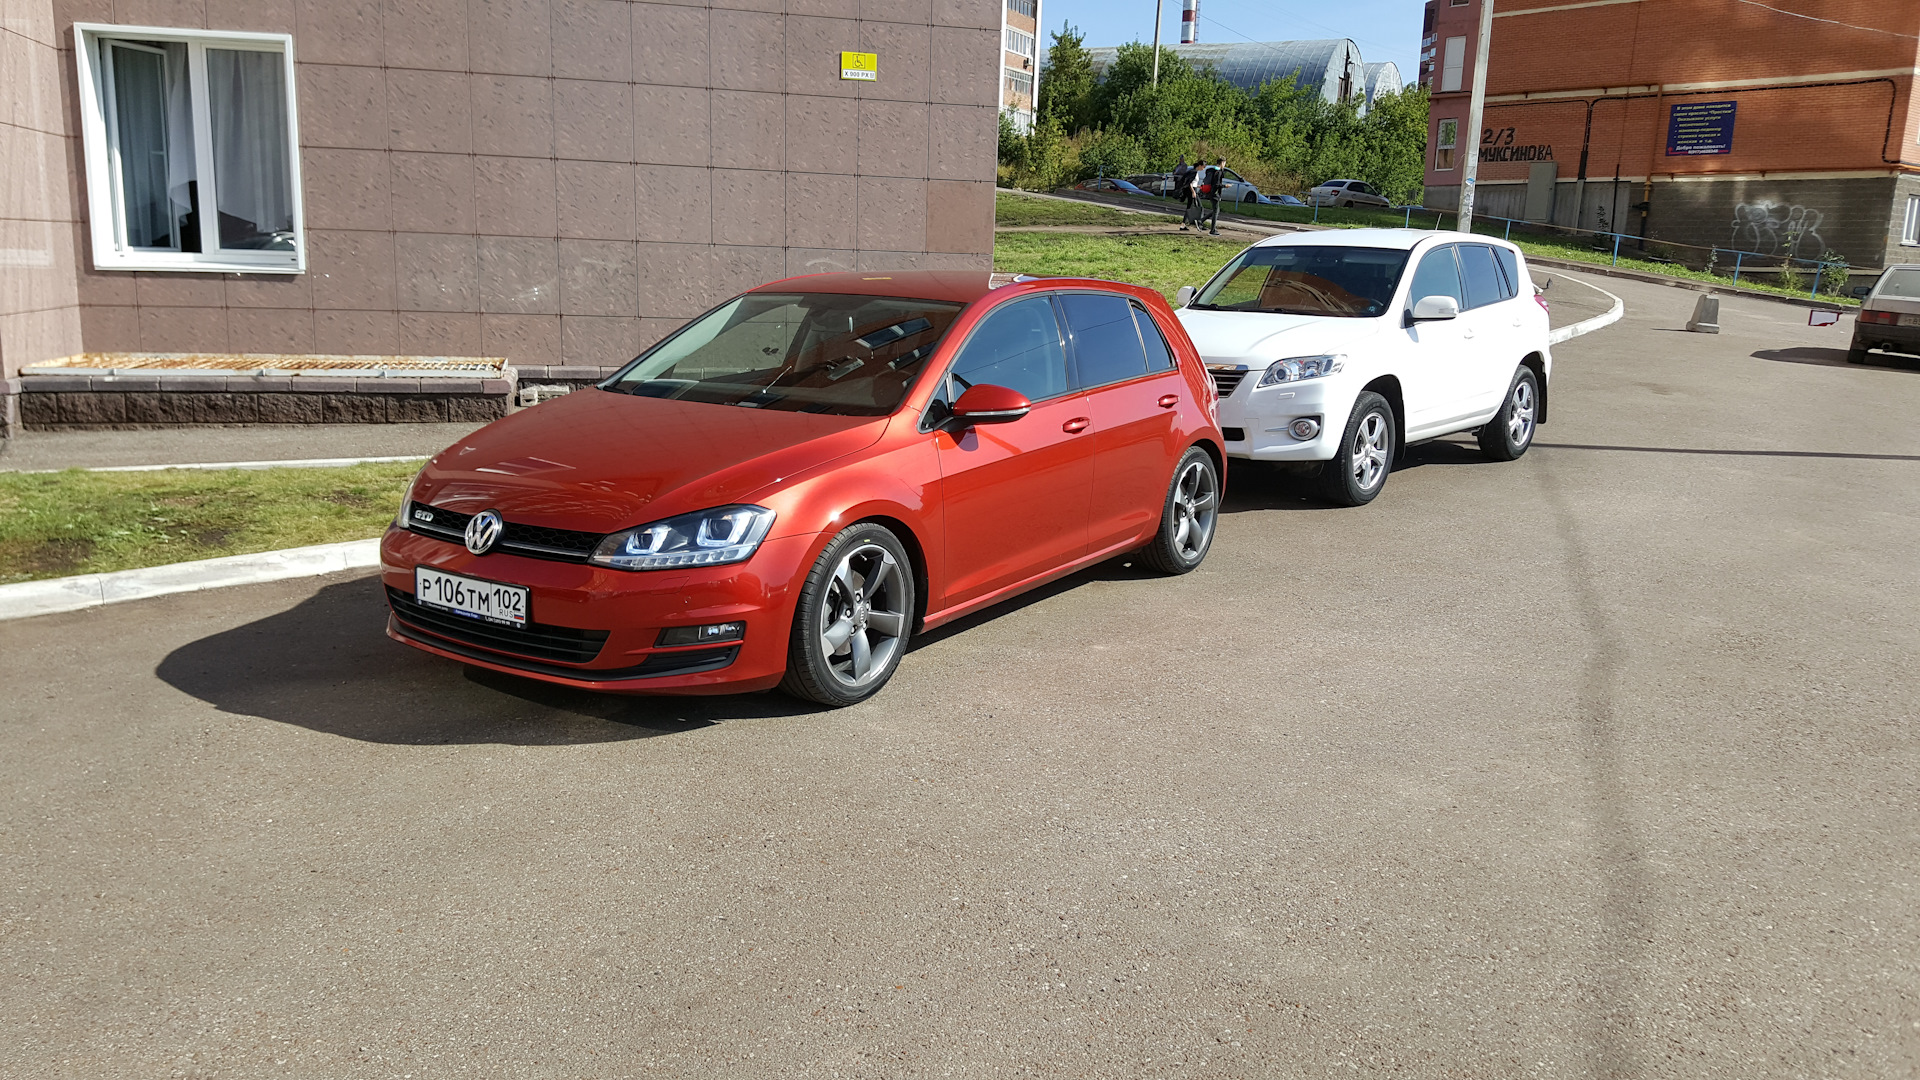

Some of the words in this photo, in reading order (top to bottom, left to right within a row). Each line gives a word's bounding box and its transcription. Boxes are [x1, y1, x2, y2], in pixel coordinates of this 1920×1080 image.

[1482, 127, 1515, 145] 2/3
[1478, 144, 1554, 162] МУКСИНОВА
[493, 588, 521, 611] 102
[499, 609, 514, 619] RUS
